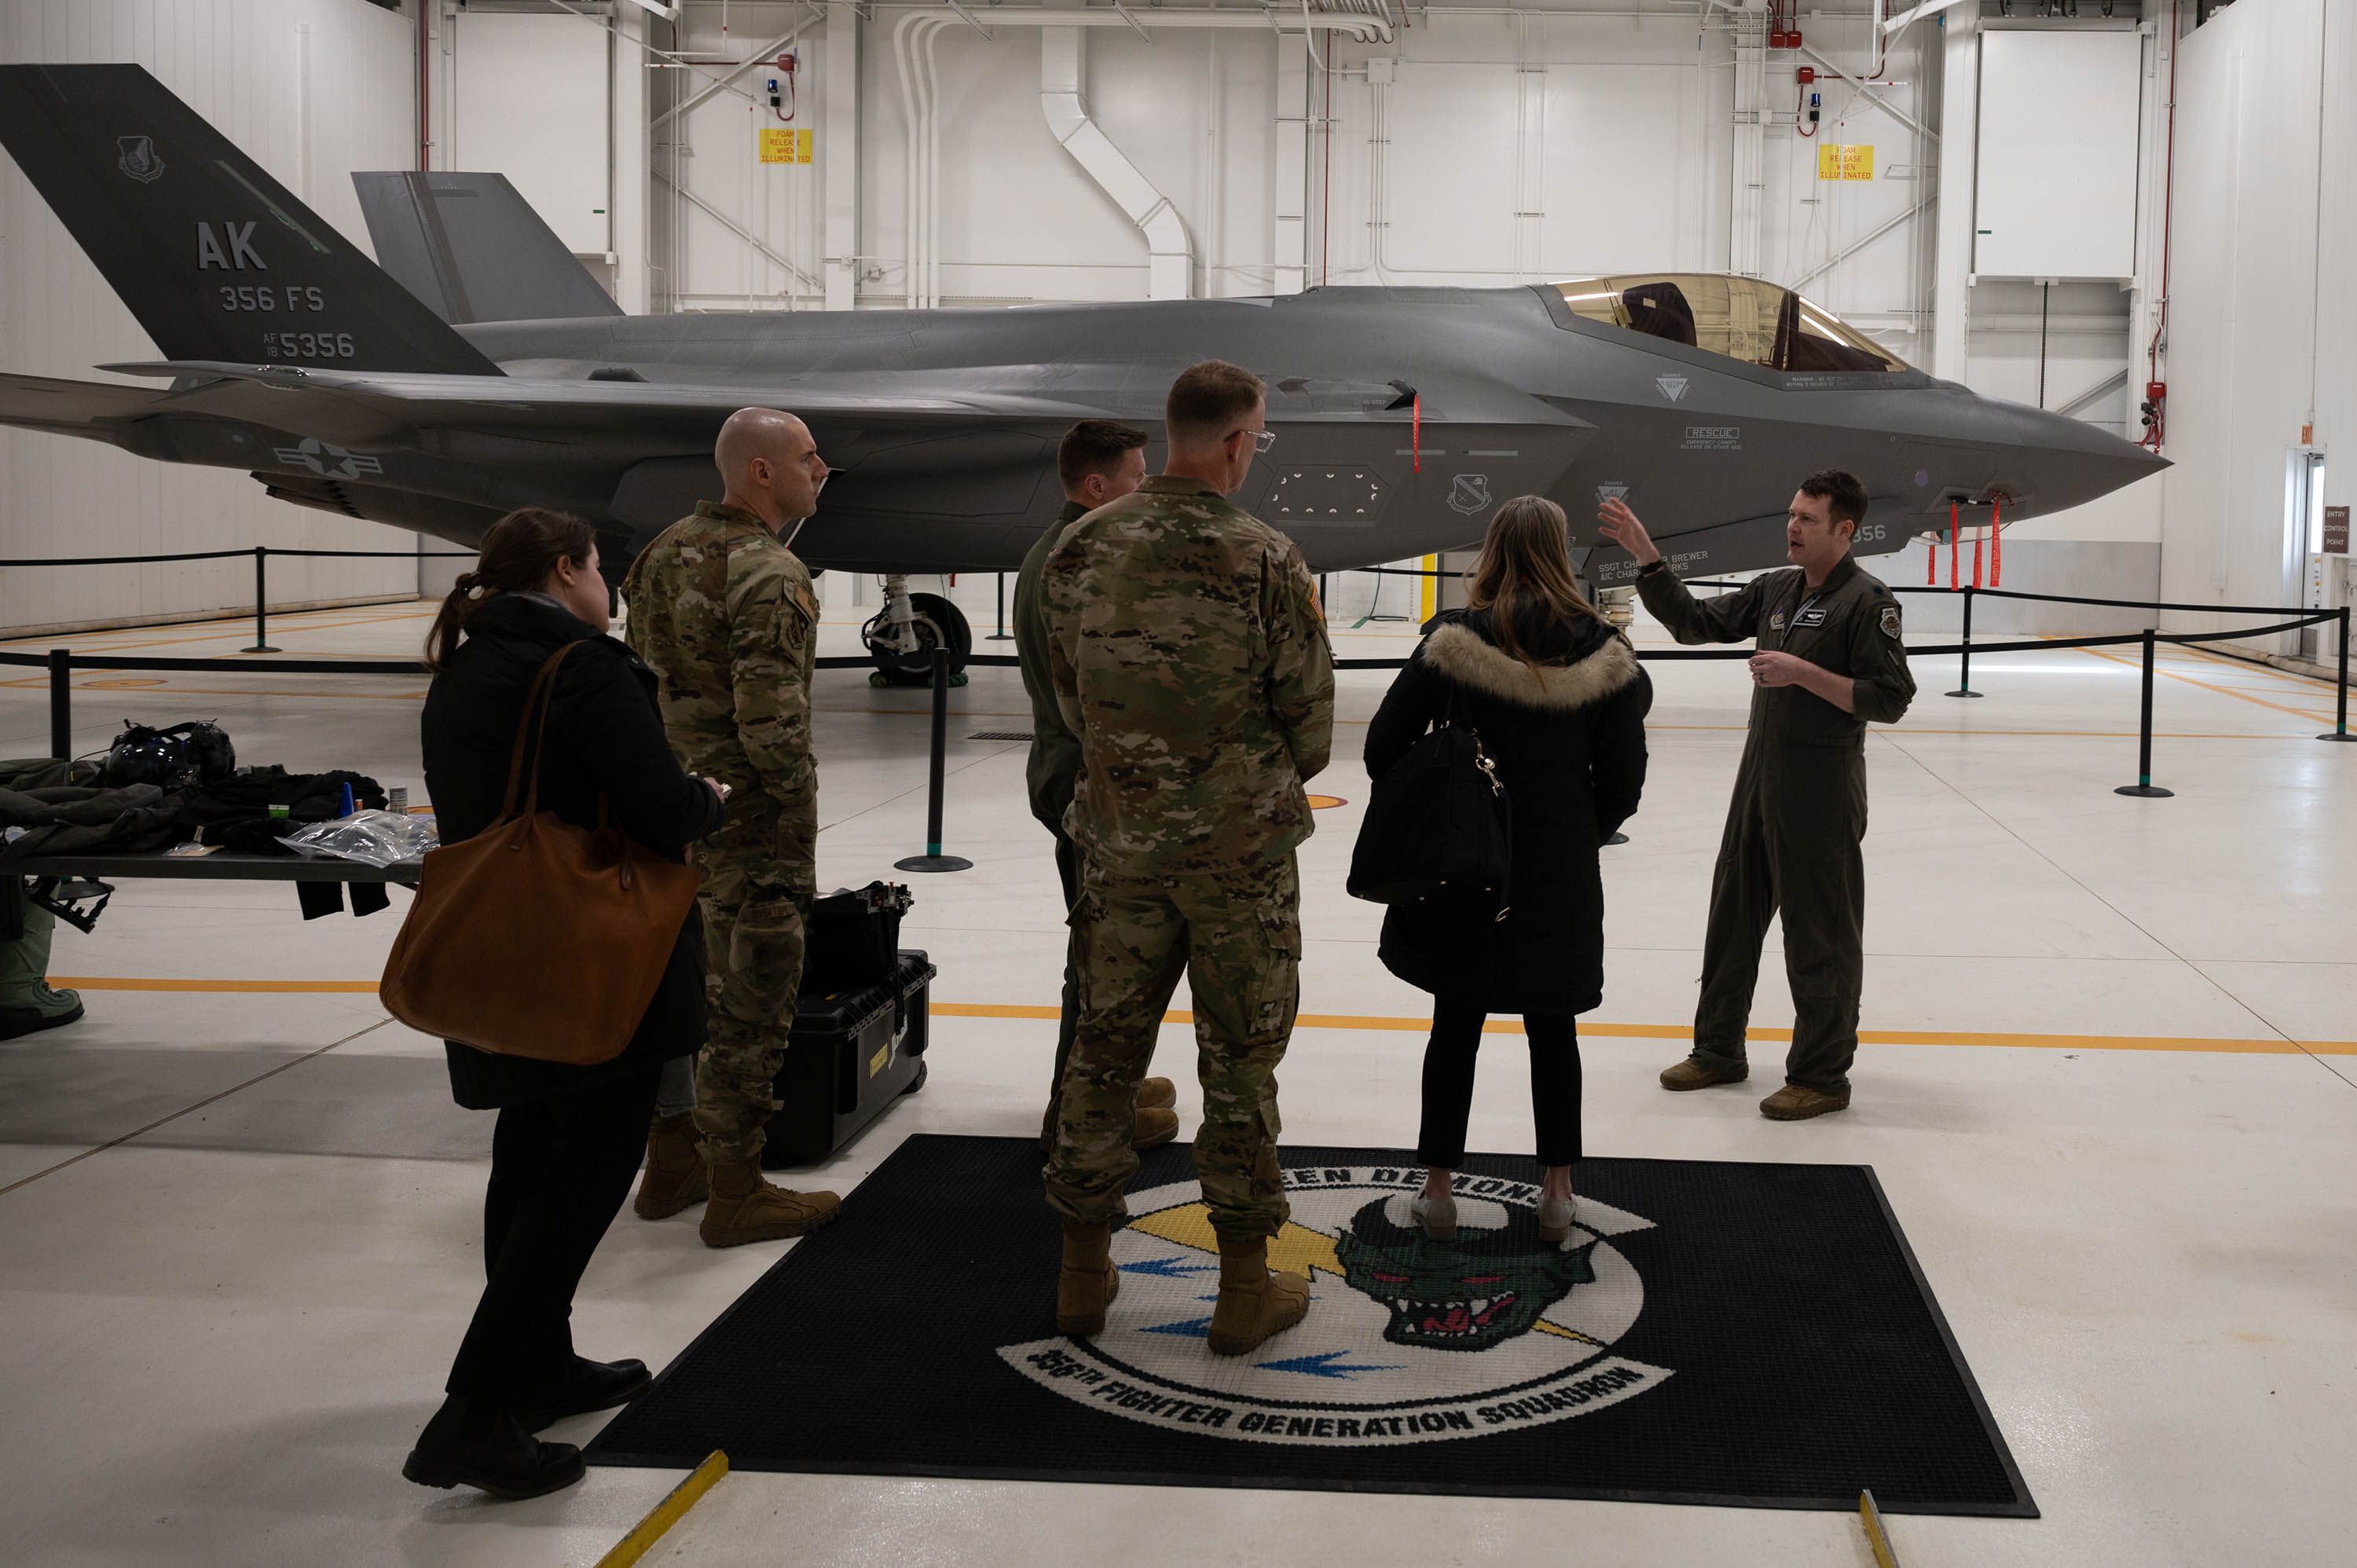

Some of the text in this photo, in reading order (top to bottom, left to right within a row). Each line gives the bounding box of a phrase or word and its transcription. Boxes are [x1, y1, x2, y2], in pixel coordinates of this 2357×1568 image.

[197, 222, 268, 269] AK
[220, 286, 324, 312] 356 FS
[264, 333, 277, 344] AF
[280, 333, 355, 359] 5356
[266, 346, 278, 358] 18
[1598, 562, 1620, 573] SSGT
[1671, 551, 1709, 563] BREWER
[1671, 562, 1689, 573] RKS
[1089, 1380, 1233, 1428] FIGHTER
[1237, 1410, 1474, 1438] GENERATION
[1476, 1366, 1646, 1424] SQUADRON
